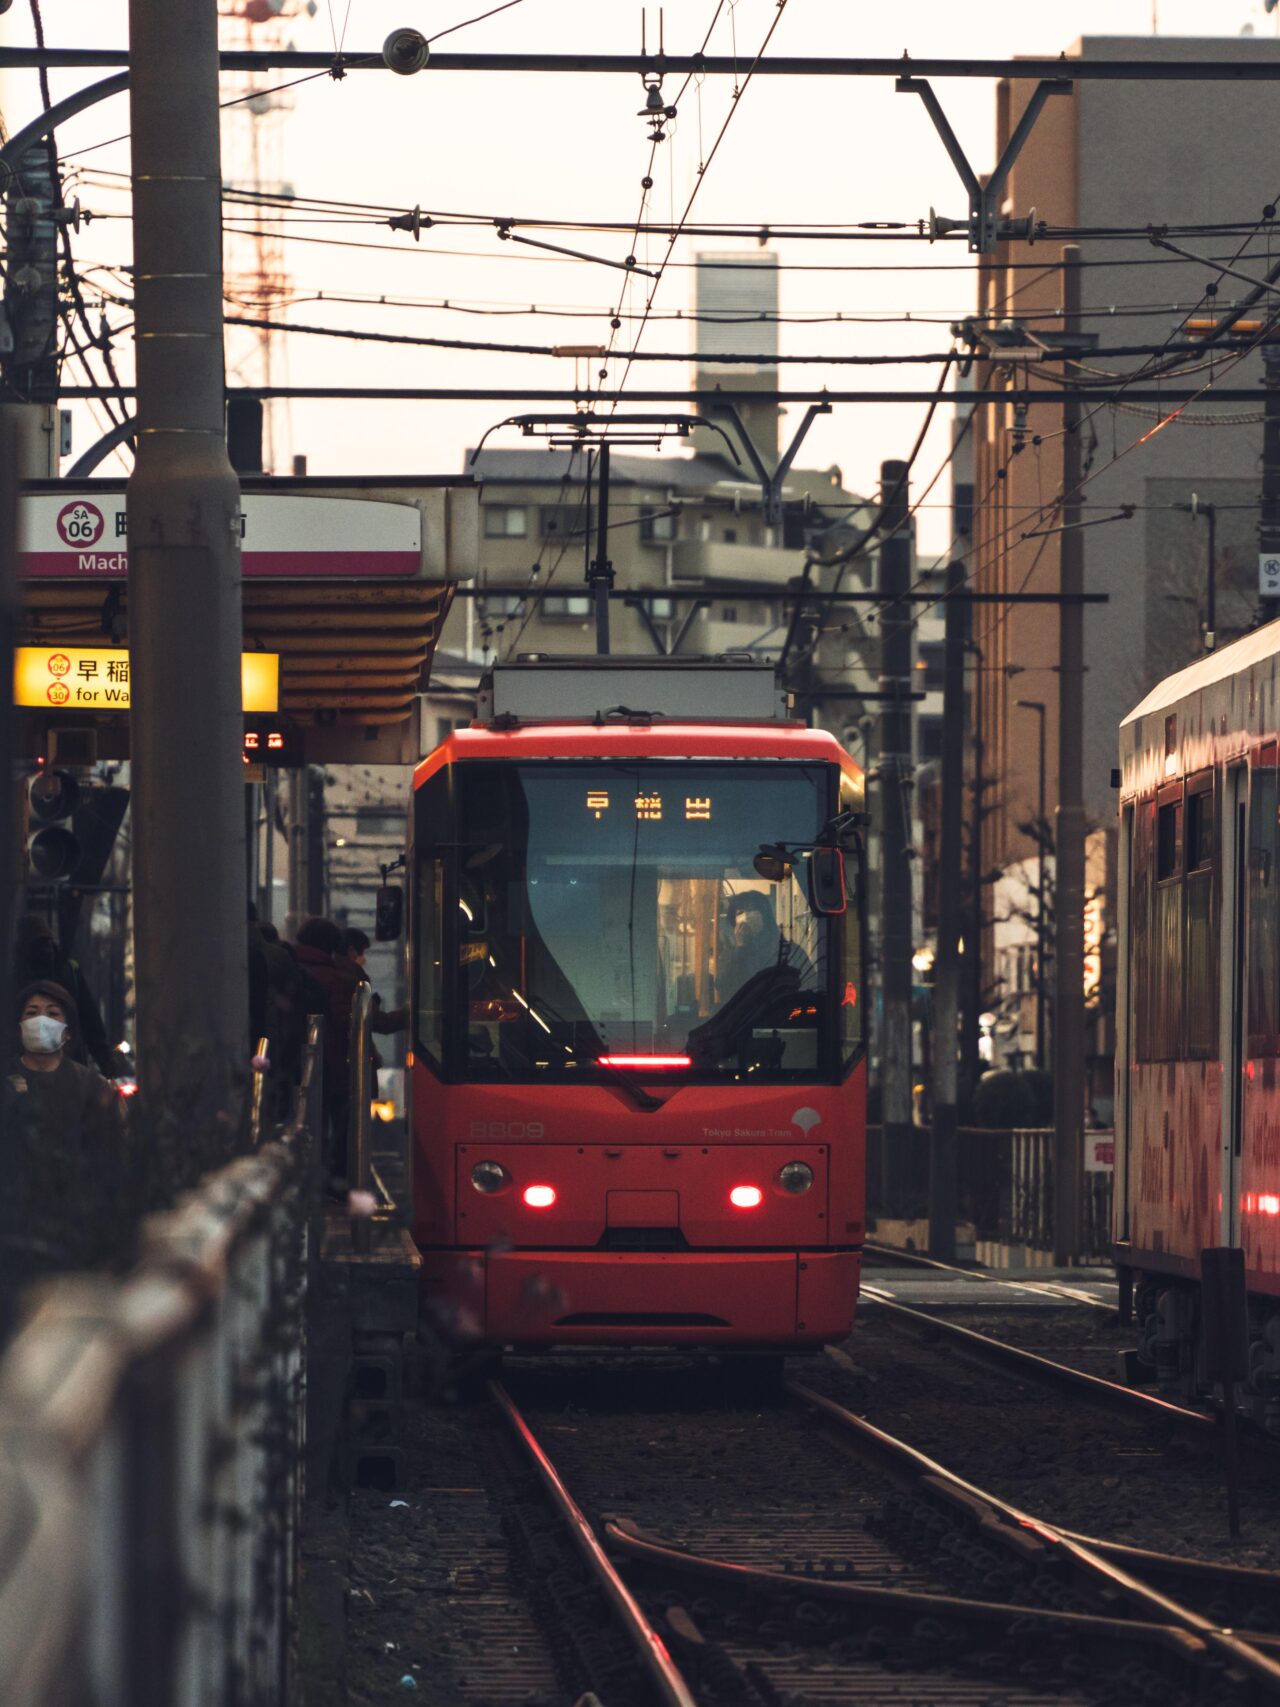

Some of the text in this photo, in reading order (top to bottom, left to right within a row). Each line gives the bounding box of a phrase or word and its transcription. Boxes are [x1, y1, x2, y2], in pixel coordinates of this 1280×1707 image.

[73, 509, 89, 520] SA
[68, 521, 93, 538] 06
[53, 663, 65, 672] 06
[52, 691, 65, 700] 30
[76, 688, 99, 701] for
[469, 1120, 545, 1138] 8809
[702, 1127, 792, 1139] Tokyo Sakura Tram
